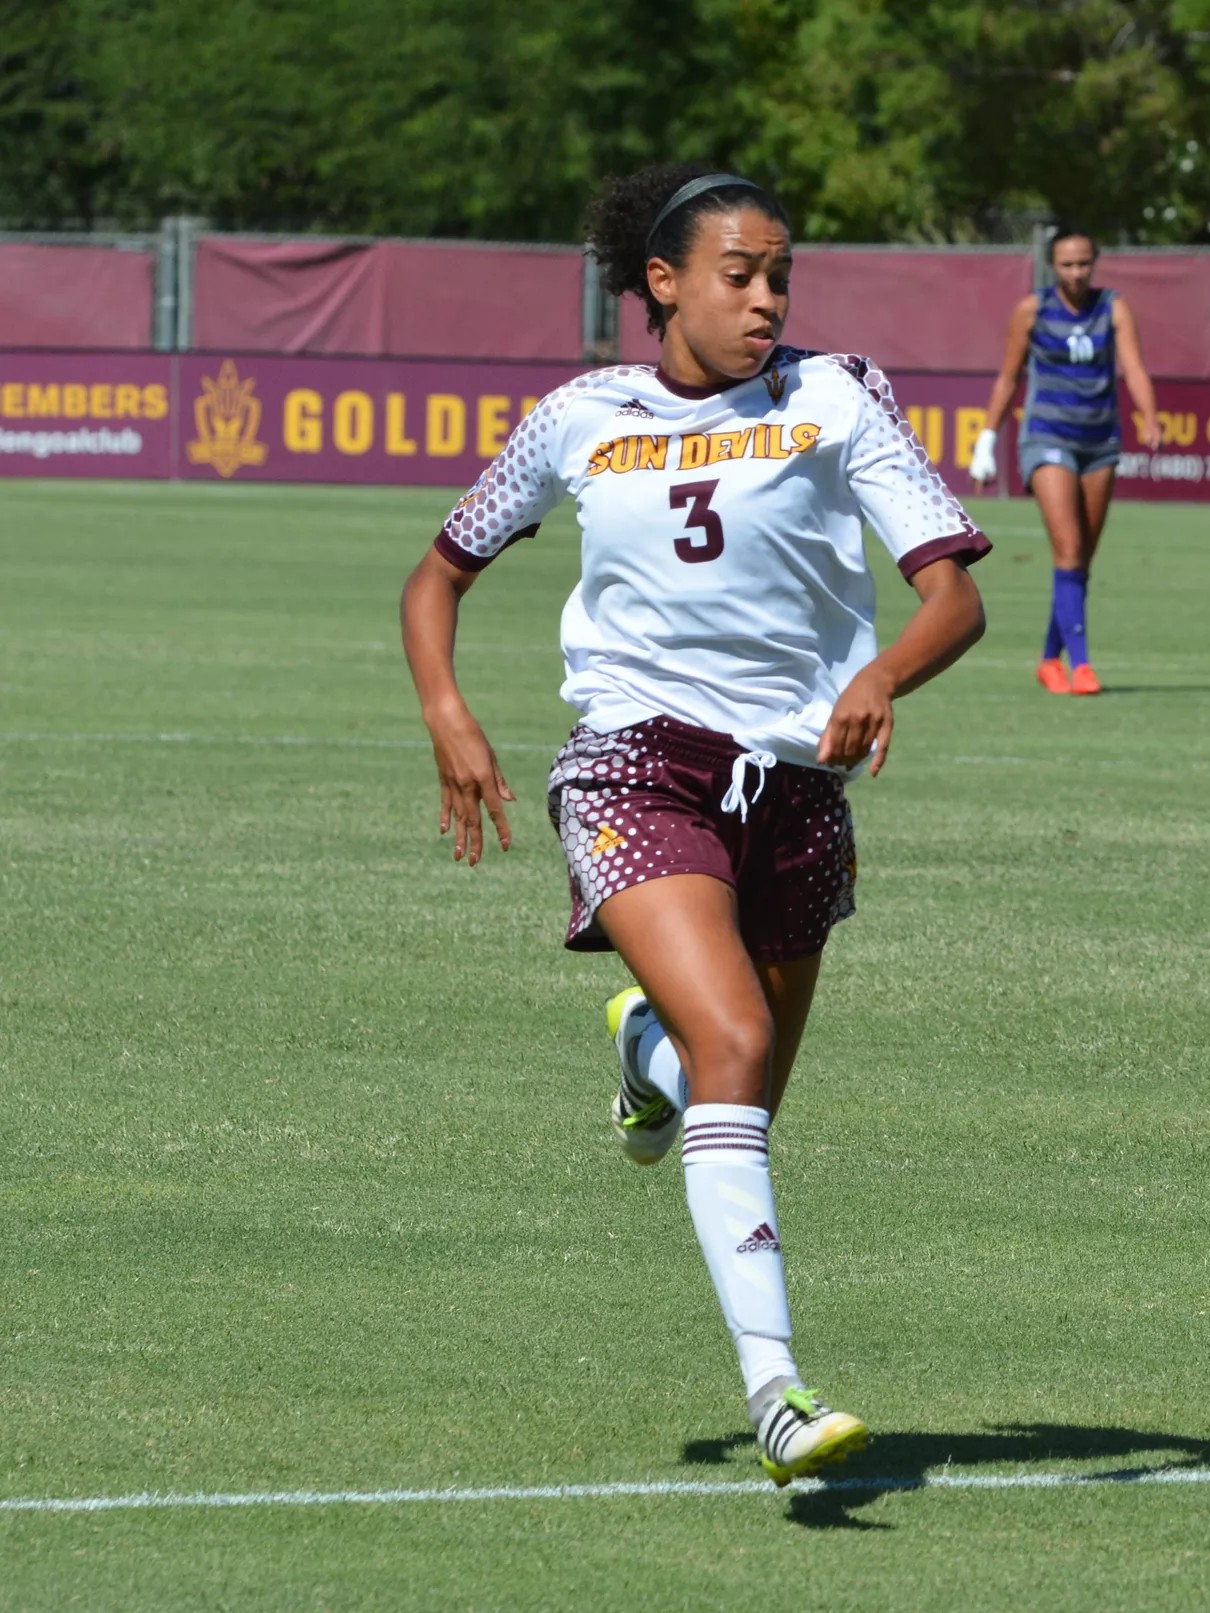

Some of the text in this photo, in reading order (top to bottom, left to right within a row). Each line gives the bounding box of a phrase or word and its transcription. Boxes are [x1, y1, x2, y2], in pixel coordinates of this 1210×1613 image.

[615, 407, 655, 420] adidas
[0, 425, 142, 458] engoalclub
[586, 422, 822, 477] SUN DEVILS
[669, 478, 725, 564] 3
